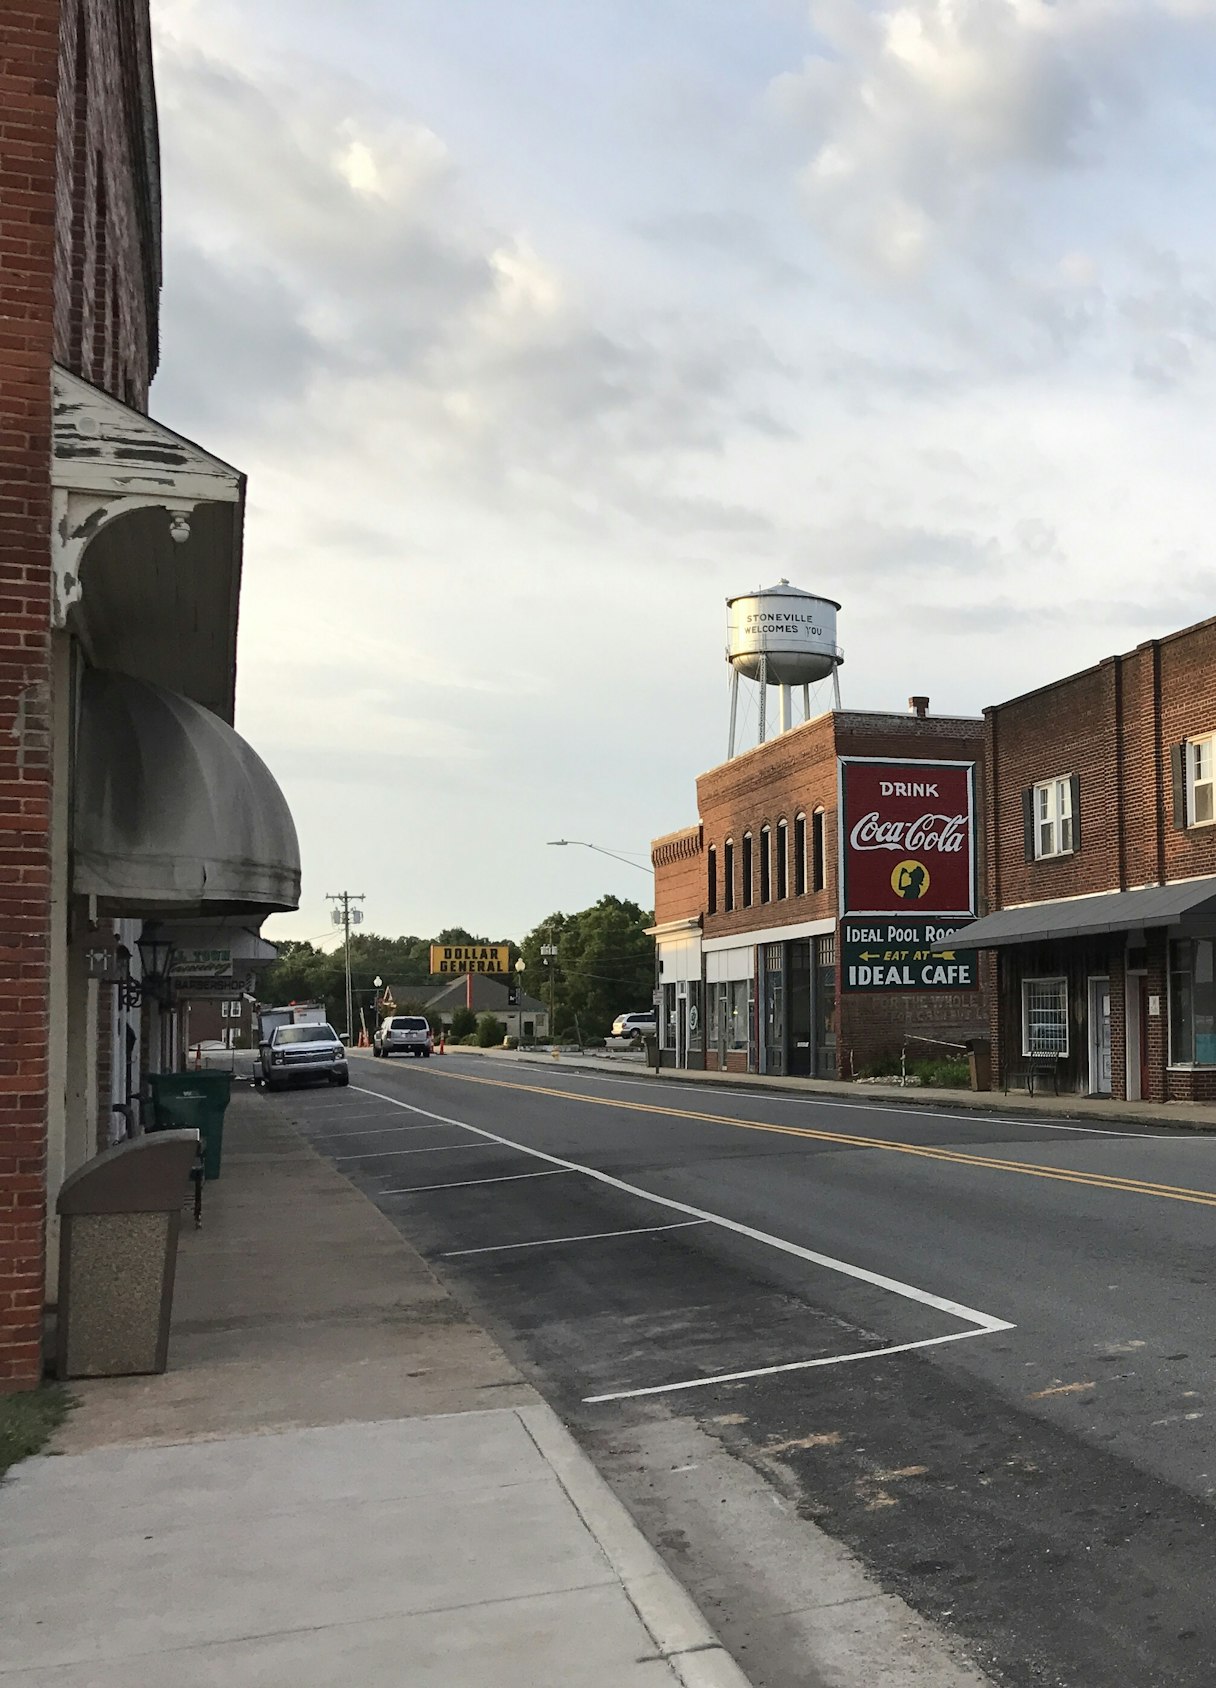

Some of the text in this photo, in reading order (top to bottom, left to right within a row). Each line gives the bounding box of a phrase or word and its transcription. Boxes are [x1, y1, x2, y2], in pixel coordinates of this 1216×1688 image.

[746, 613, 813, 623] STONEVILLE
[745, 625, 822, 637] WELCOMES YOU
[879, 781, 939, 798] DRINK
[850, 811, 969, 852] Coca-Cola
[846, 925, 885, 943] IDEAL
[887, 925, 920, 943] POOL
[444, 948, 499, 959] DOLLAR
[883, 950, 931, 960] EAT AT
[440, 961, 503, 972] GENERAL
[849, 965, 971, 986] IDEAL CAFE
[175, 980, 245, 990] BARBERSHOP
[902, 996, 928, 1008] THE
[930, 994, 977, 1008] WHOLE
